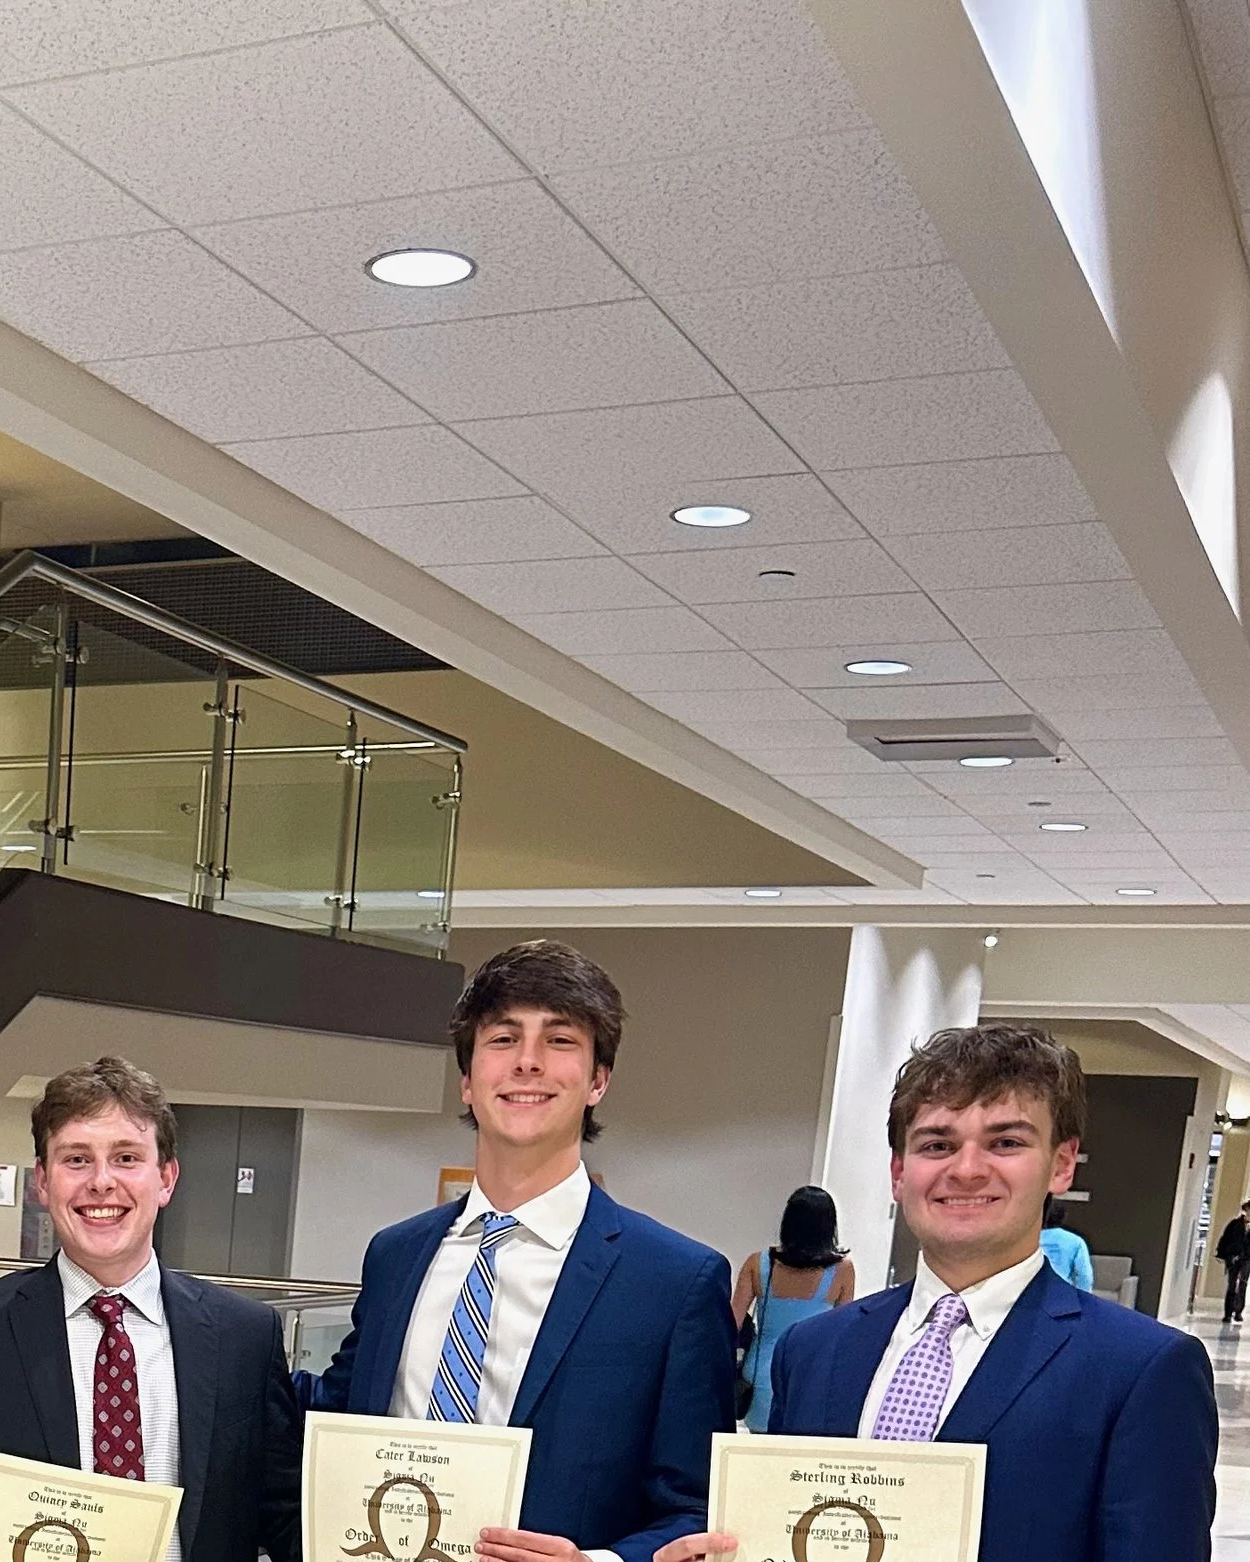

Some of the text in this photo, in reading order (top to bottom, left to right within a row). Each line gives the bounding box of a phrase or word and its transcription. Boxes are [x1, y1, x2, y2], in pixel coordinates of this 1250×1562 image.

[375, 1448, 450, 1465] Cater Lawson
[789, 1469, 905, 1487] Sterling Robbins
[28, 1491, 68, 1508] Quincy
[70, 1499, 104, 1513] Sauls
[345, 1528, 472, 1555] Order of Omega
[785, 1524, 840, 1537] University
[841, 1528, 851, 1538] of
[855, 1529, 899, 1541] Alabama
